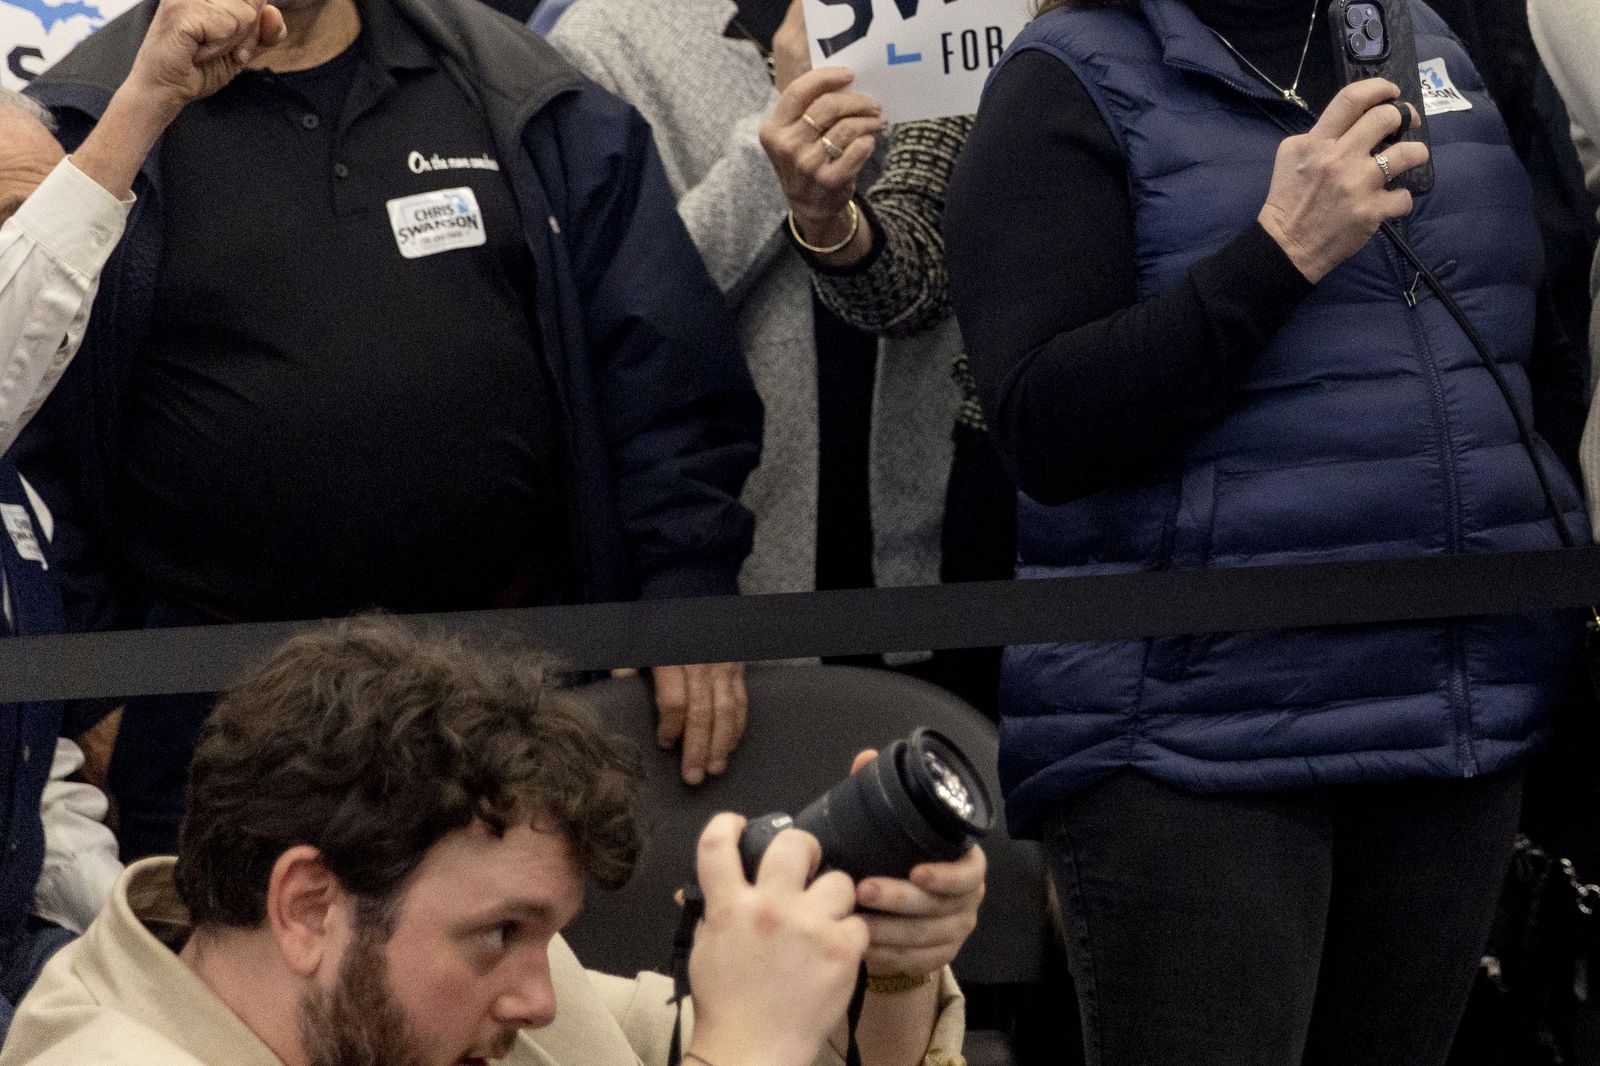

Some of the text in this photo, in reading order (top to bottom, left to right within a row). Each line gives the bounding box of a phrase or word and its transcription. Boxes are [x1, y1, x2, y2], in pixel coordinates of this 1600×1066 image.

[941, 25, 1004, 75] FOR
[415, 204, 454, 222] CHRIS
[398, 215, 479, 244] SWANSON
